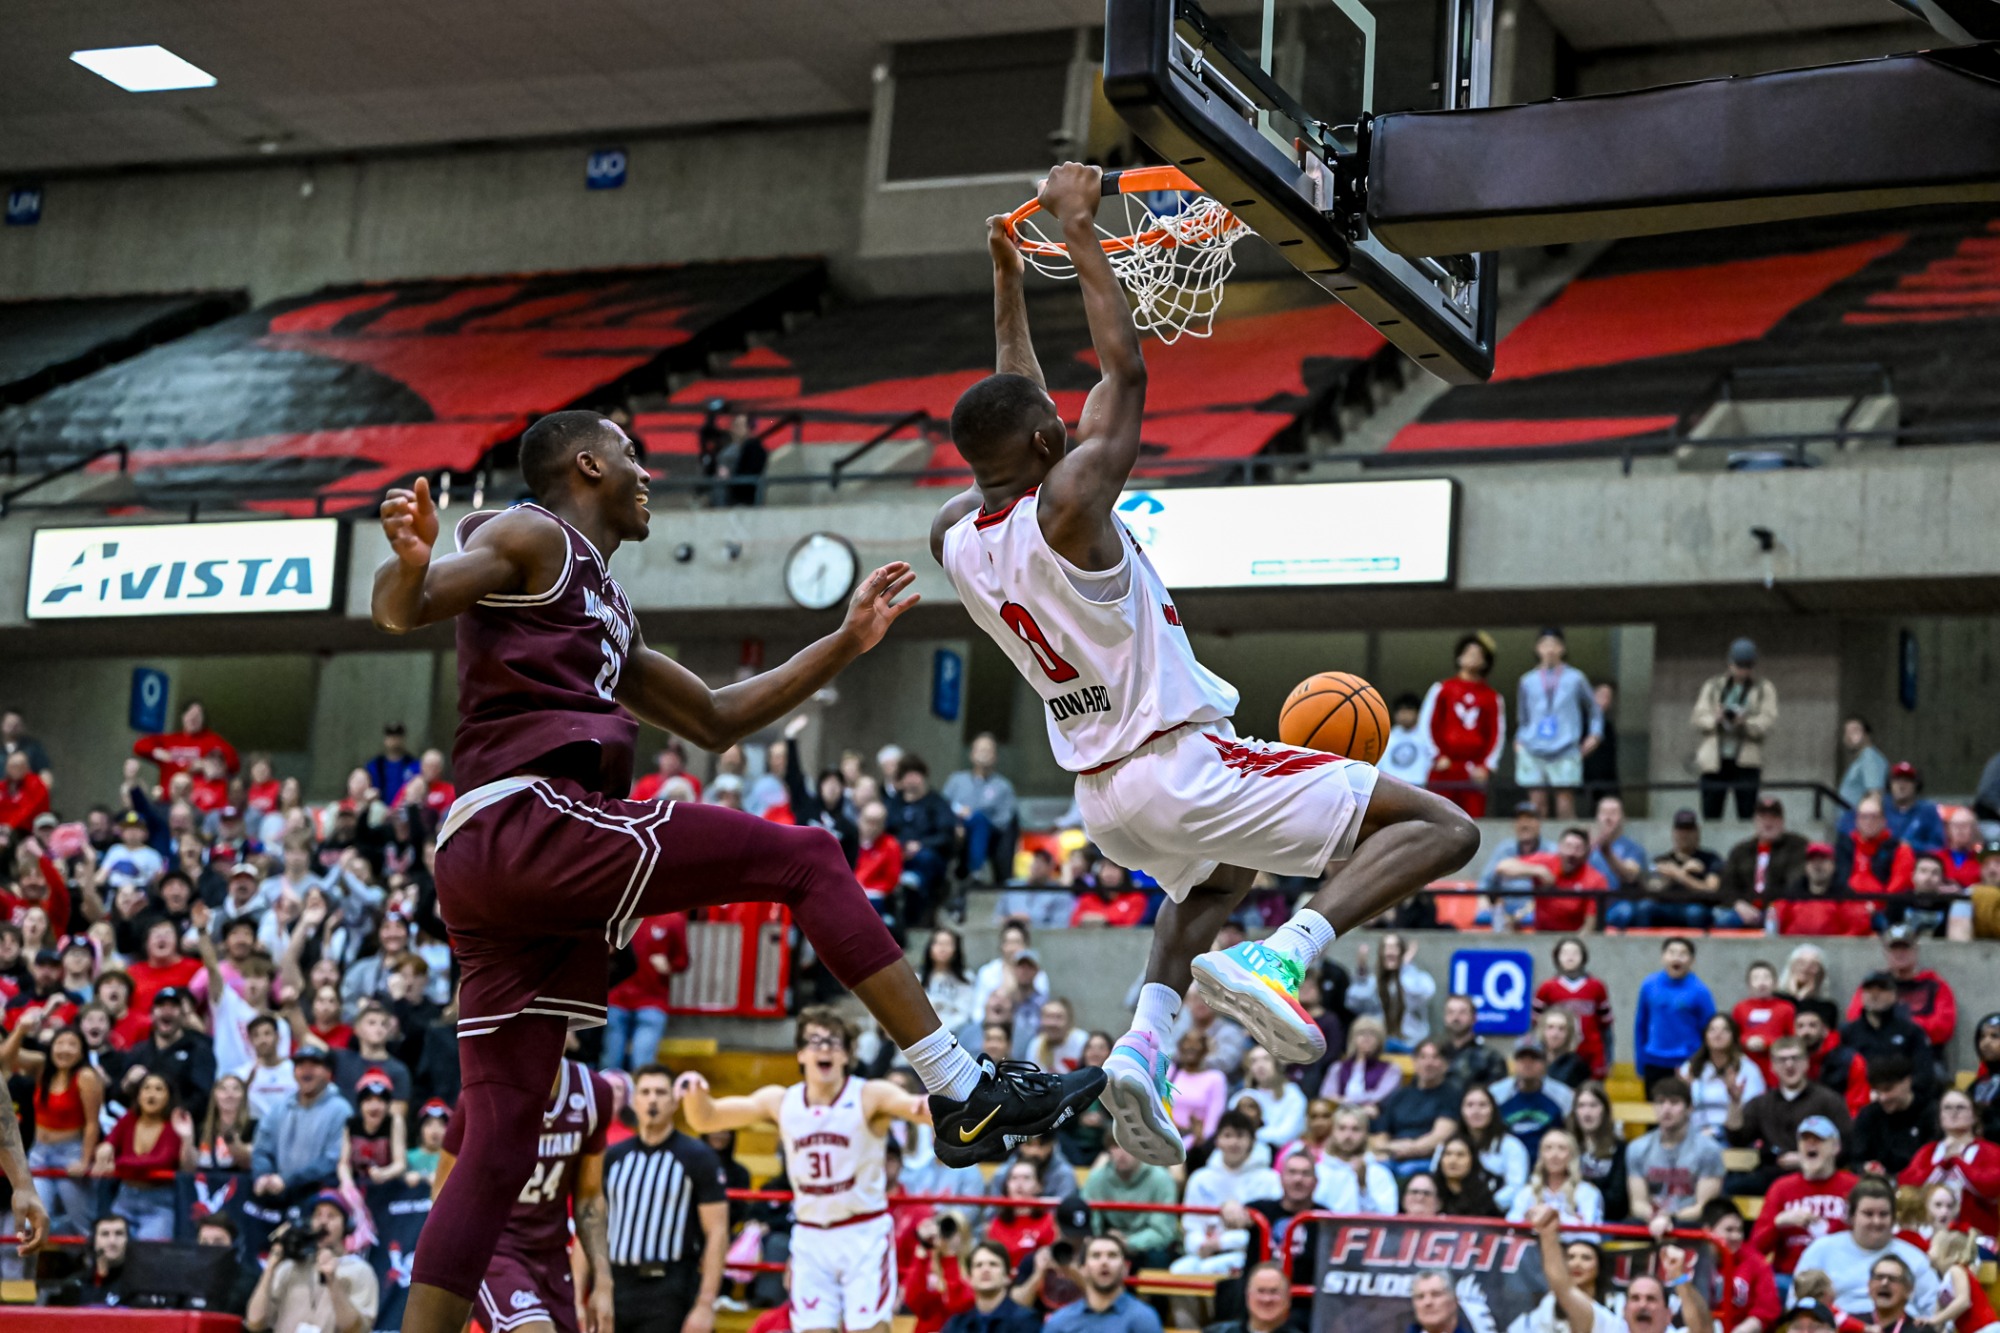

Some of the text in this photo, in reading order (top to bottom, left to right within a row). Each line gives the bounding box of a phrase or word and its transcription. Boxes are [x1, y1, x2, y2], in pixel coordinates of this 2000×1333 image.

[42, 543, 313, 604] AVISTA
[583, 586, 631, 658] MONTAN
[1000, 600, 1079, 684] 0
[1045, 685, 1111, 722] OWARD
[1454, 960, 1526, 1011] LQ
[808, 1152, 832, 1178] 31
[1329, 1226, 1537, 1274] FLIGHT
[1322, 1270, 1416, 1299] STUDE
